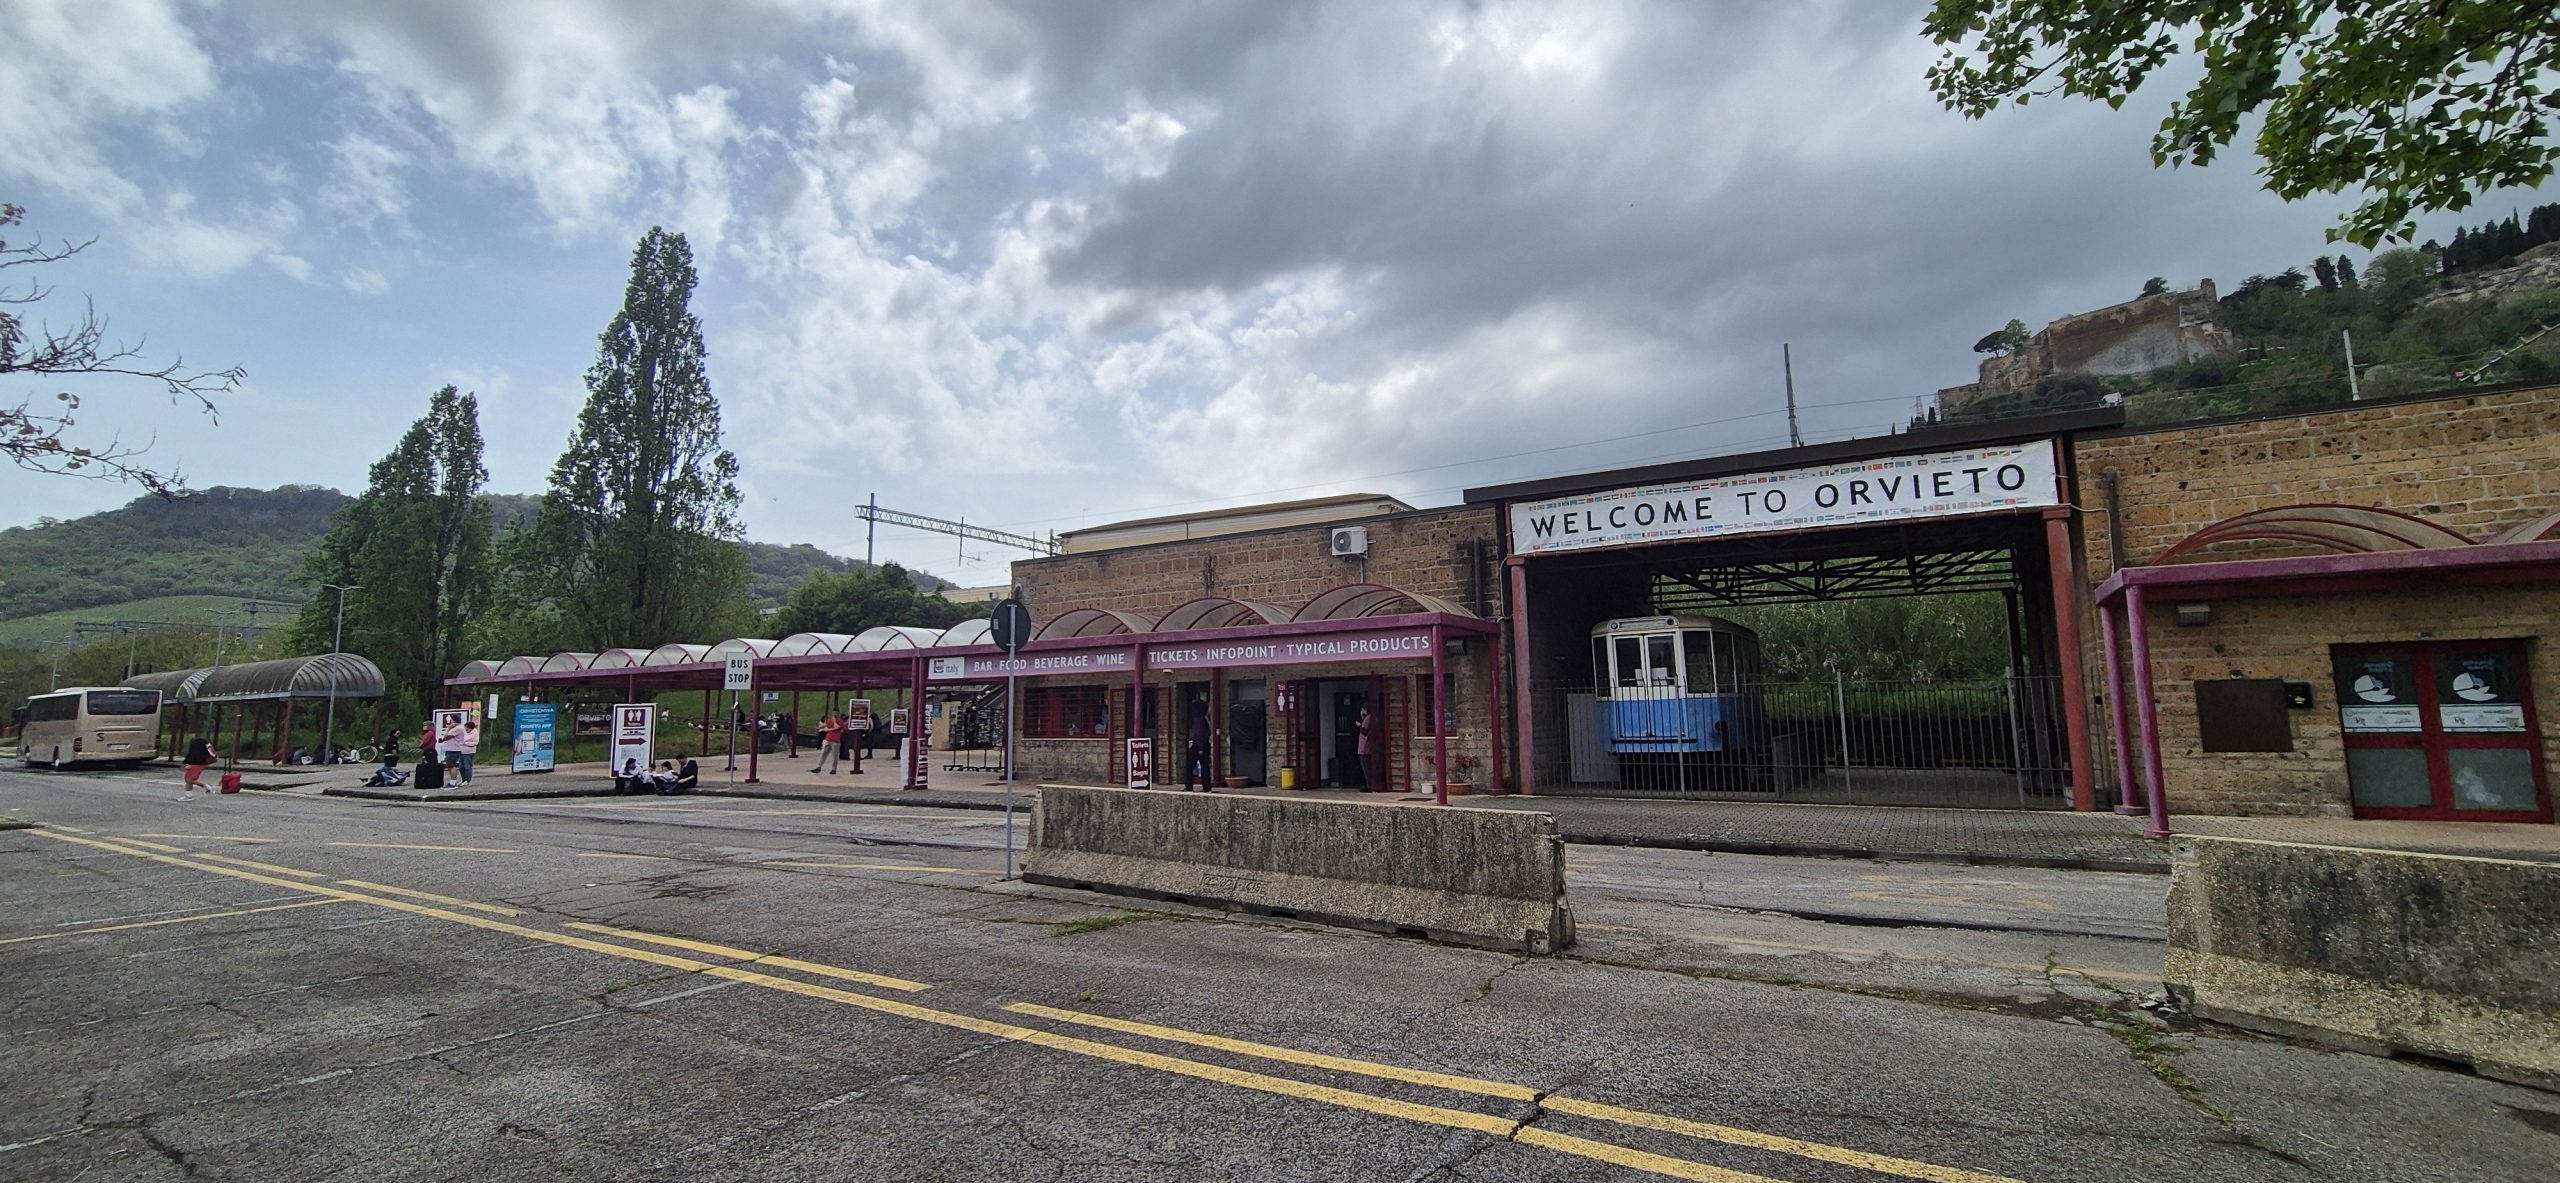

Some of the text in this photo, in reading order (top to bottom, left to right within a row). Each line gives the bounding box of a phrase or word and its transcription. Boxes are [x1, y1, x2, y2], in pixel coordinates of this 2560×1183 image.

[1530, 464, 2025, 538] WELCOME TO ORVIETO
[1149, 635, 1430, 663] TICKETS INFOPOINT TYPICAL PRODUCTS
[731, 659, 748, 669] BUS
[974, 660, 993, 672] BAR
[1034, 655, 1089, 669] BEVERAGE
[1096, 653, 1125, 666] WINE
[728, 673, 750, 683] STOP
